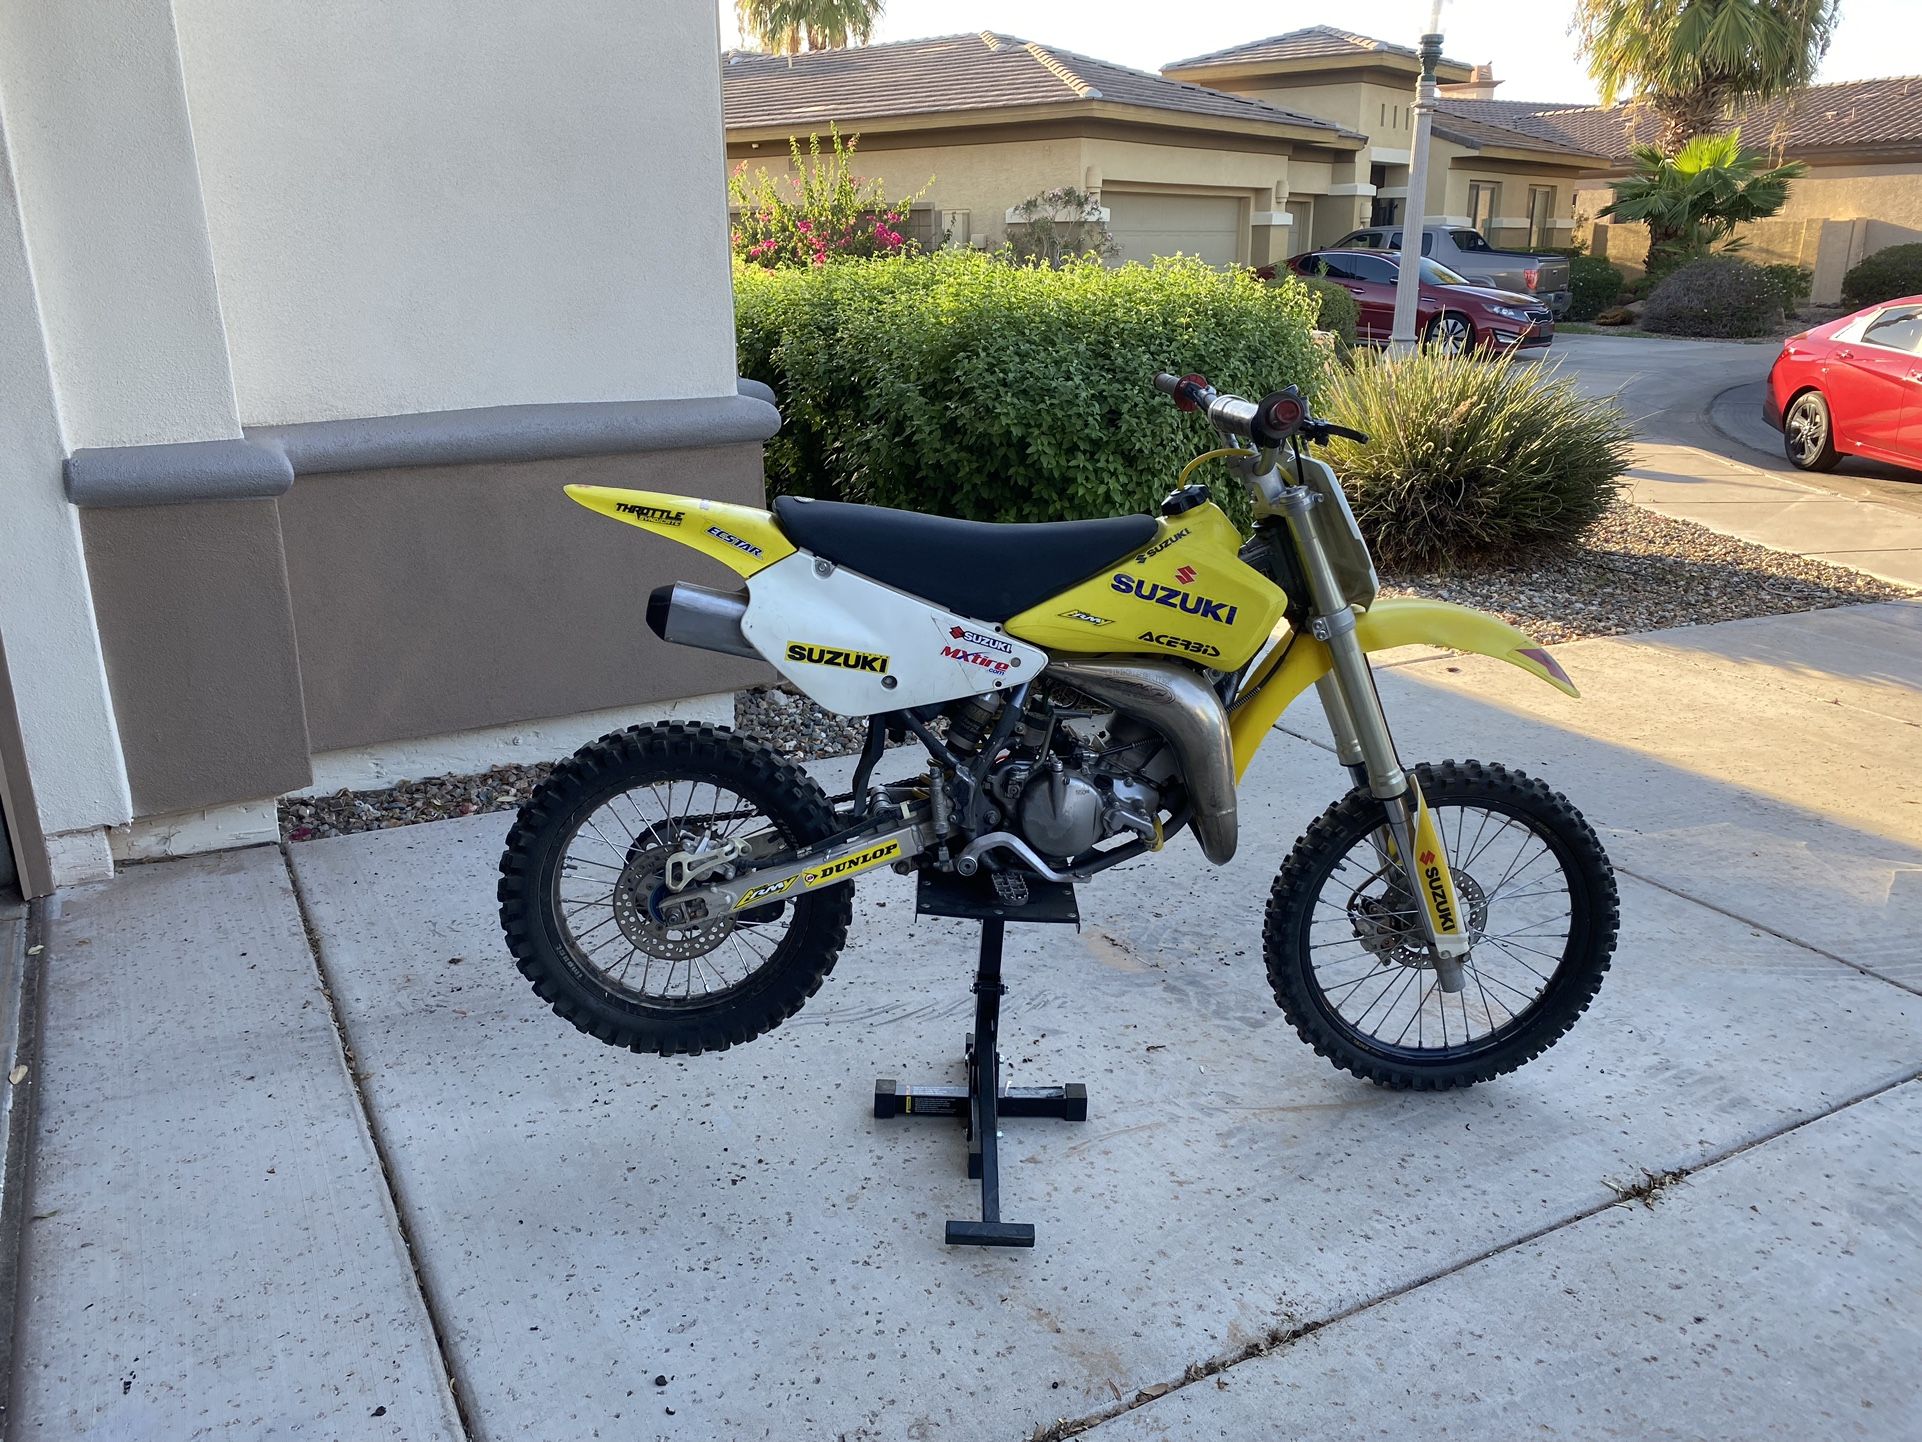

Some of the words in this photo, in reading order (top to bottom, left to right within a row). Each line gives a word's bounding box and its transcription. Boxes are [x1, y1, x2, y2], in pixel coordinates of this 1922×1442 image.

[616, 502, 685, 521] THROTTLE
[707, 526, 763, 557] ECSTAR
[1146, 528, 1191, 557] SUZUKI
[1111, 573, 1237, 625] SUZUKI
[964, 631, 1011, 652] SUZUKI
[788, 645, 887, 673] SUZUKI
[821, 843, 897, 878] DUNLOP
[1425, 866, 1455, 931] SUZUKI
